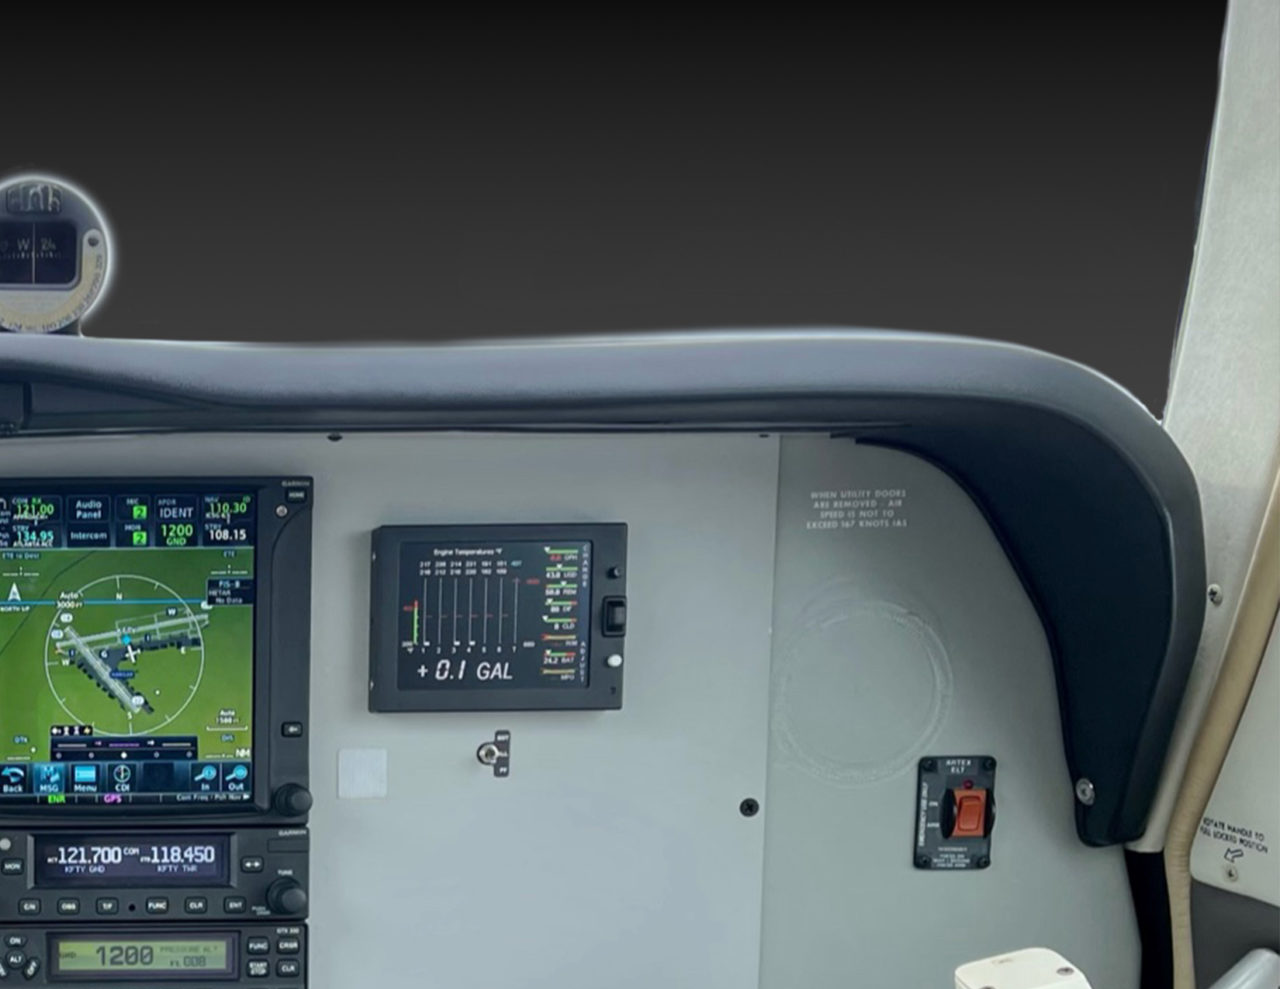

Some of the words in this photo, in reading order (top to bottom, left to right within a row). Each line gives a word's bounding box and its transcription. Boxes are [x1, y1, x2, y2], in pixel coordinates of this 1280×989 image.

[811, 491, 837, 499] WHEN
[840, 490, 870, 498] UTILITY
[875, 490, 906, 498] DOORS
[76, 500, 102, 509] Audio
[210, 503, 246, 514] 110.30
[813, 501, 830, 509] ARE
[833, 500, 877, 508] REMOVED
[888, 499, 902, 507] AIR
[76, 510, 102, 519] Panel
[160, 507, 194, 518] IDENT
[860, 510, 878, 518] NOT
[883, 510, 894, 518] TO
[806, 521, 838, 529] EXCEED
[859, 520, 889, 528] KNOTS
[892, 519, 907, 527] IAS
[162, 524, 193, 536] 1200
[70, 532, 107, 540] Intercom
[210, 530, 246, 540] 108.15
[166, 538, 186, 546] GND
[417, 665, 428, 678] +
[434, 660, 466, 680] 0.1
[476, 662, 513, 680] GAL
[2, 784, 22, 793] Back
[40, 784, 58, 793] MSG
[74, 784, 98, 792] Menu
[115, 784, 130, 792] CDI
[228, 782, 244, 791] Out
[104, 794, 122, 804] GPS
[58, 846, 122, 864] 121.700
[151, 846, 216, 864] 118.450
[65, 866, 86, 874] KFTY
[89, 866, 105, 874] GND
[96, 946, 154, 966] 1200
